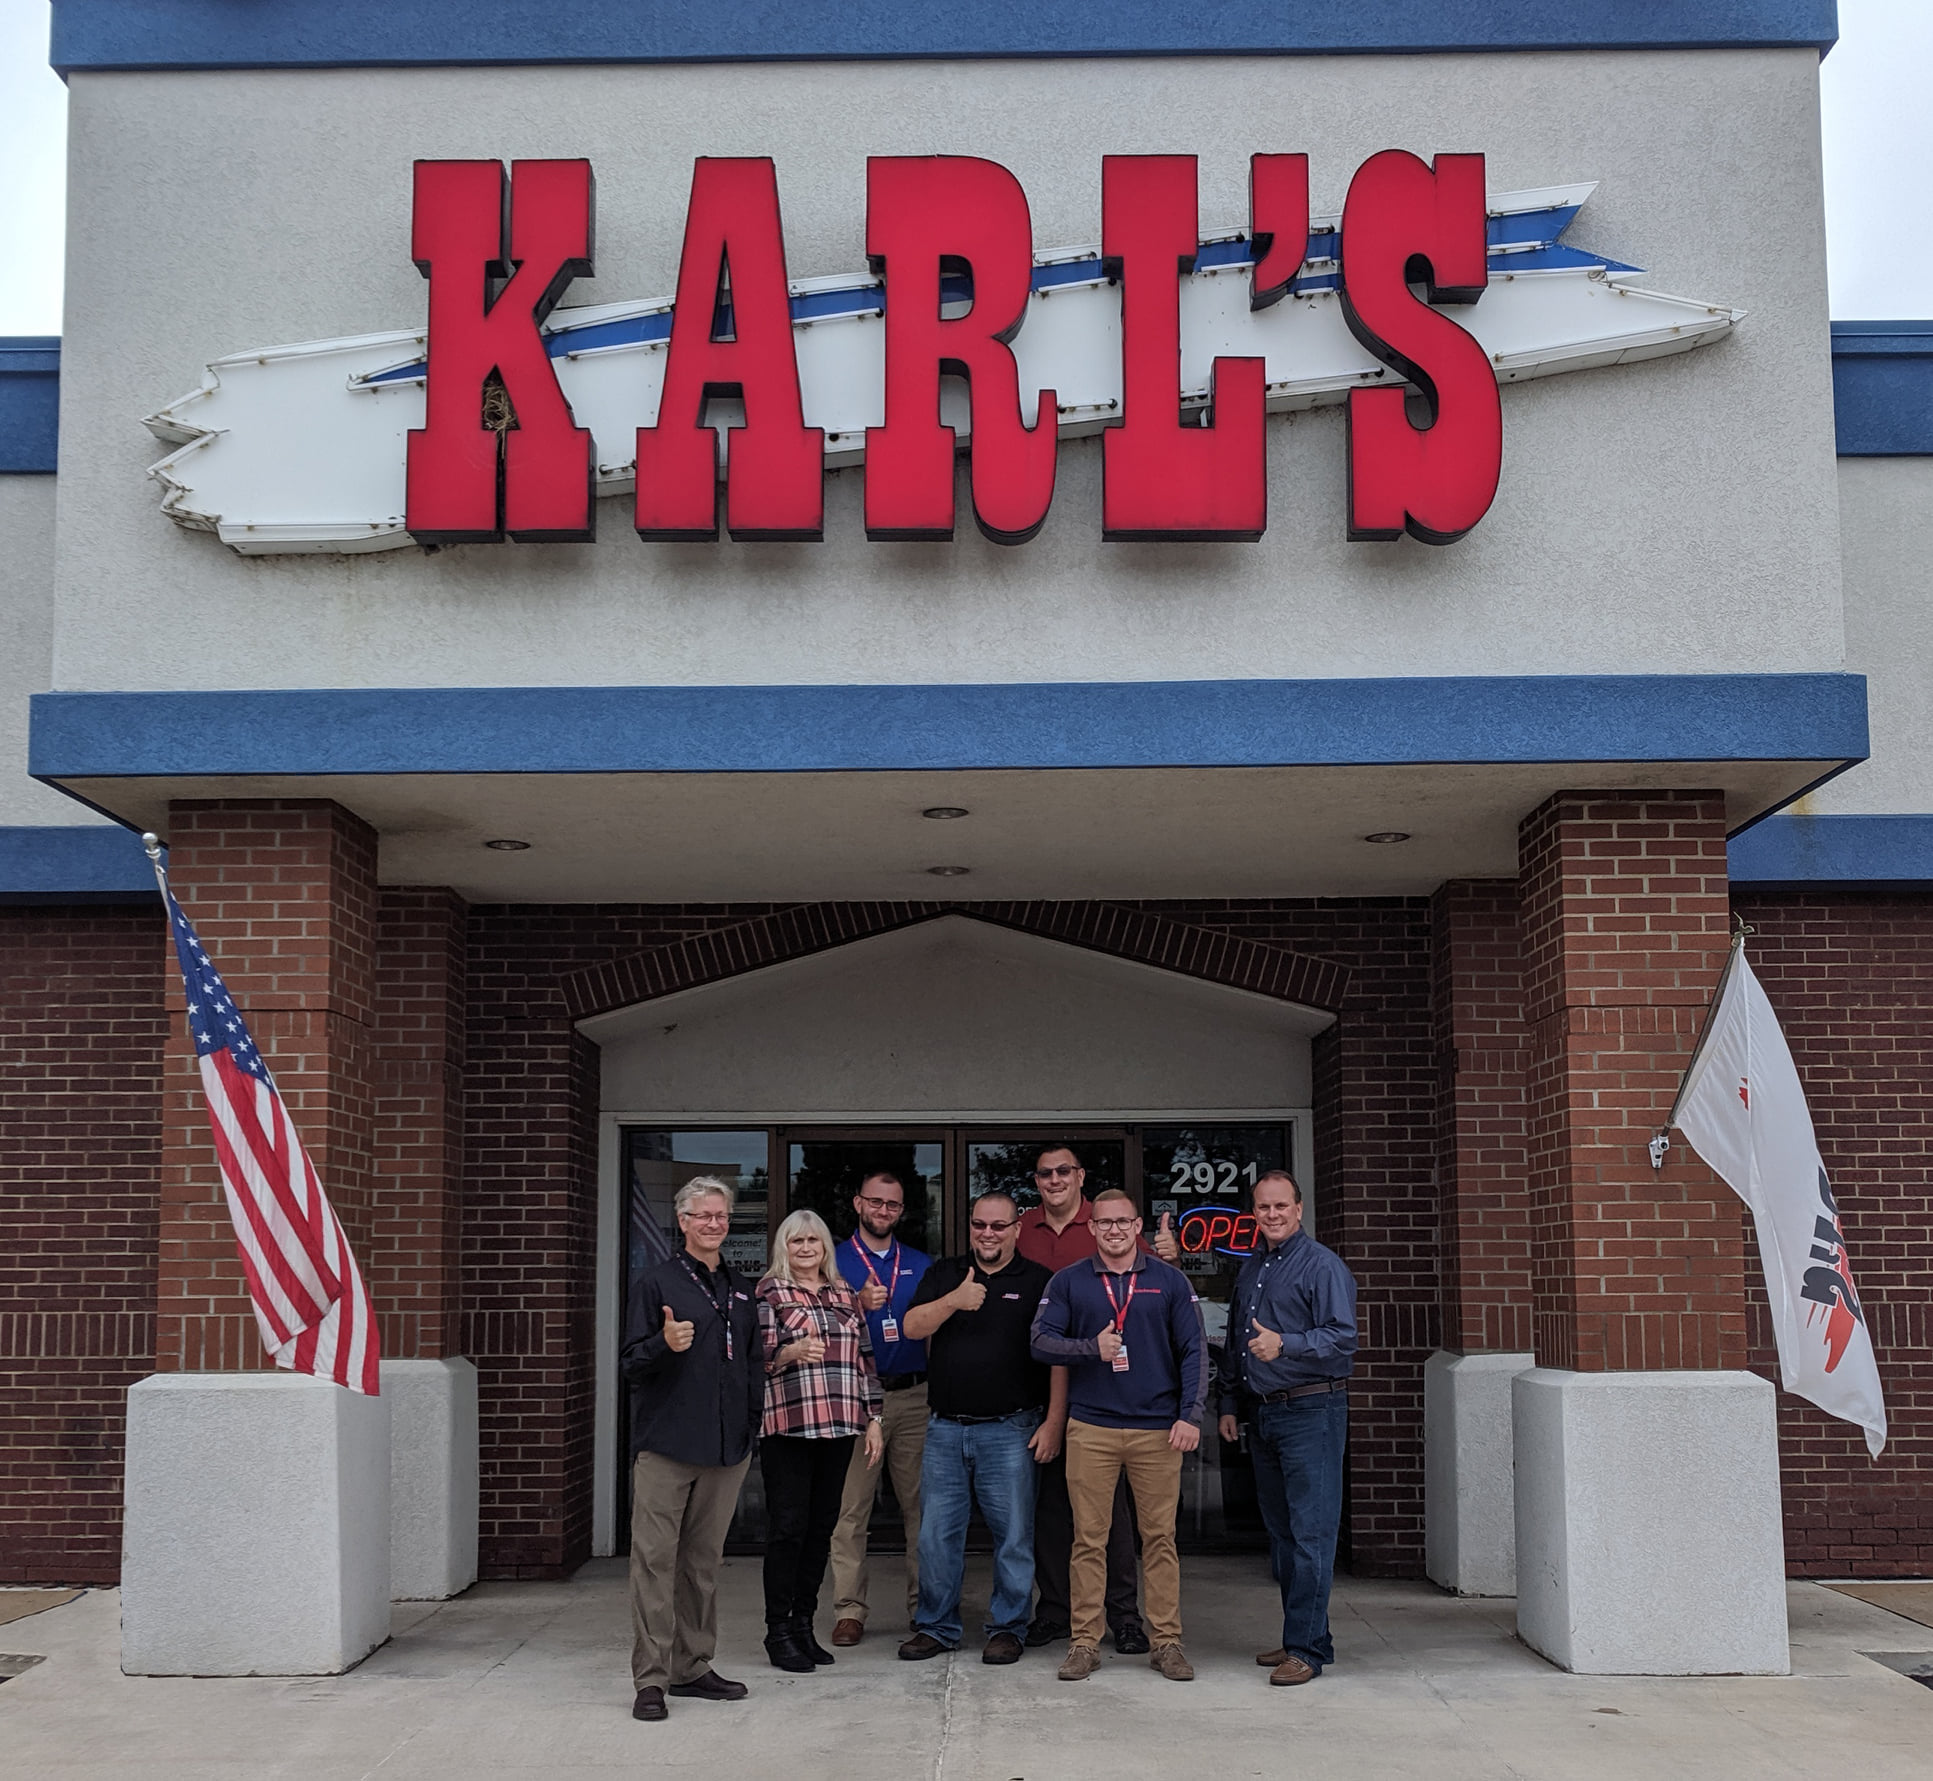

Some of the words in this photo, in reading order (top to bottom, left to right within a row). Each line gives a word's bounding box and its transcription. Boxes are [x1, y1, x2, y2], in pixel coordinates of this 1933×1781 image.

[406, 149, 1503, 545] KARL'S
[1170, 1161, 1258, 1194] 2921
[722, 1238, 762, 1248] elcome!
[732, 1249, 744, 1258] to
